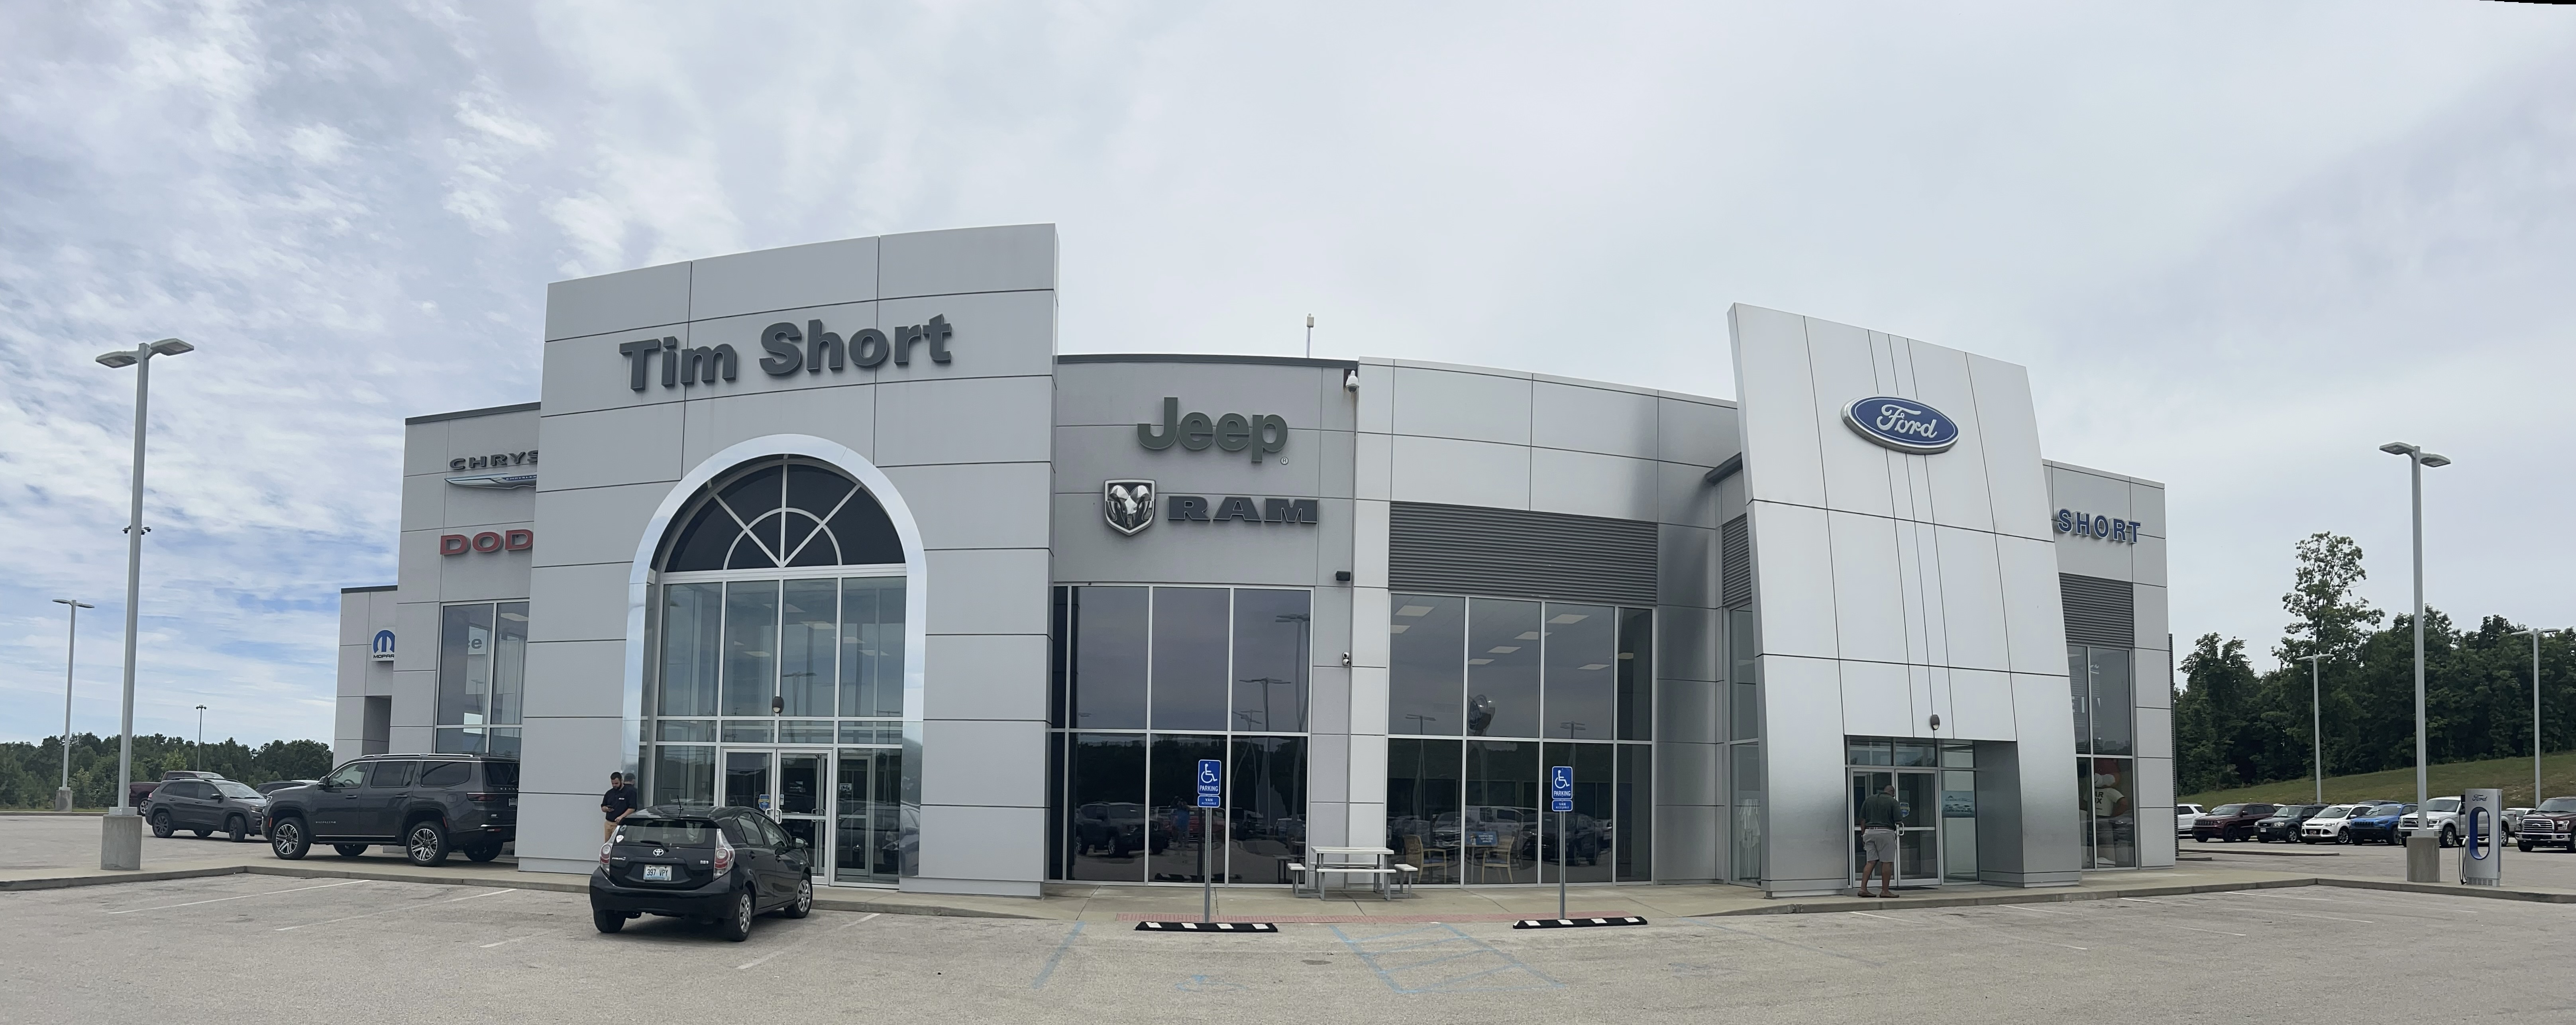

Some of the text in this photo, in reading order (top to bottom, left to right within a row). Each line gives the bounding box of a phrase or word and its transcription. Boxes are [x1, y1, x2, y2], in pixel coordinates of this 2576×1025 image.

[619, 313, 952, 391] Tim Short
[1137, 397, 1288, 463] Jeep
[1876, 404, 1938, 438] Ford
[1168, 495, 1318, 523] RAM
[2057, 508, 2141, 544] SHORT
[440, 529, 534, 555] DOD
